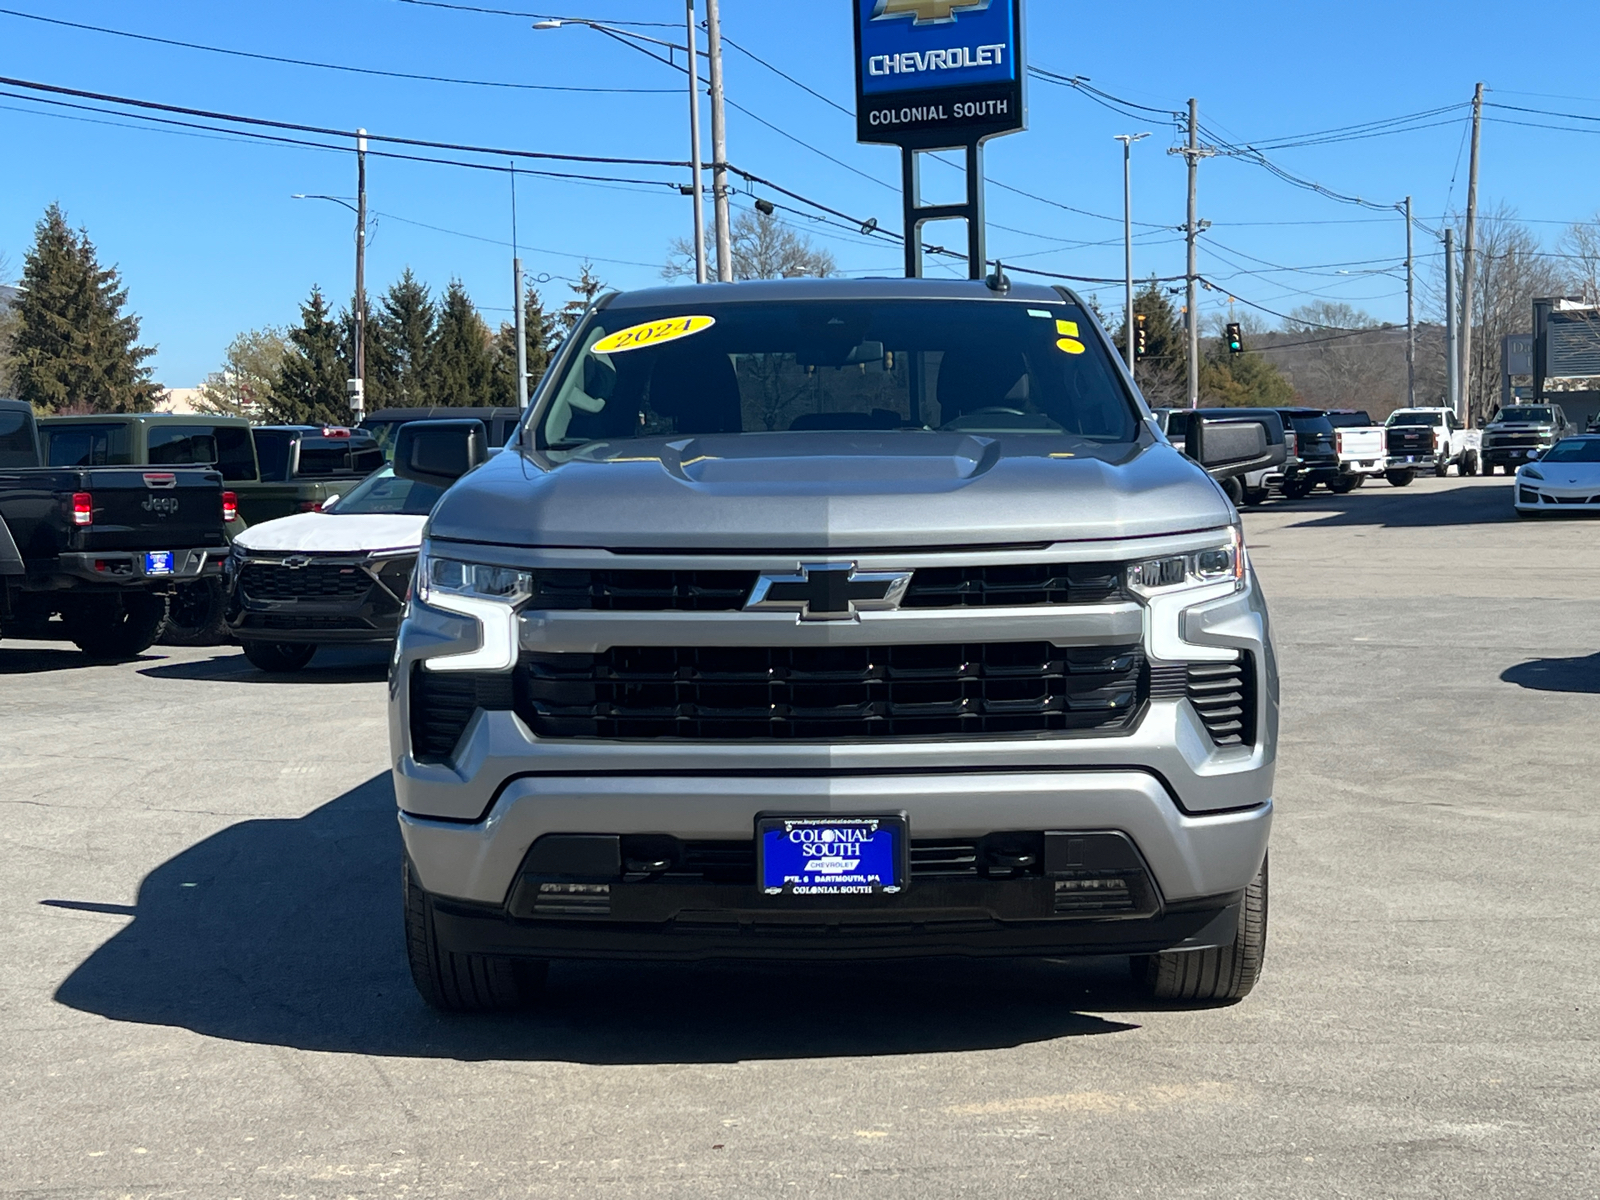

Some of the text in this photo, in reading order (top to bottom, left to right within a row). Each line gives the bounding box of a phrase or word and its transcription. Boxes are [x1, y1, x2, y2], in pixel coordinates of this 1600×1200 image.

[869, 43, 1006, 76] CHEVROLET
[869, 99, 1008, 126] COLONIAL SOUTH
[614, 318, 693, 349] 2024
[141, 494, 179, 514] Jeep
[789, 829, 874, 843] COLONIAL
[802, 843, 860, 856] SOUTH
[810, 861, 854, 869] CHEVROLET
[814, 875, 866, 883] DARTMOUTH,
[793, 885, 872, 894] COLONIAL SOUTH
